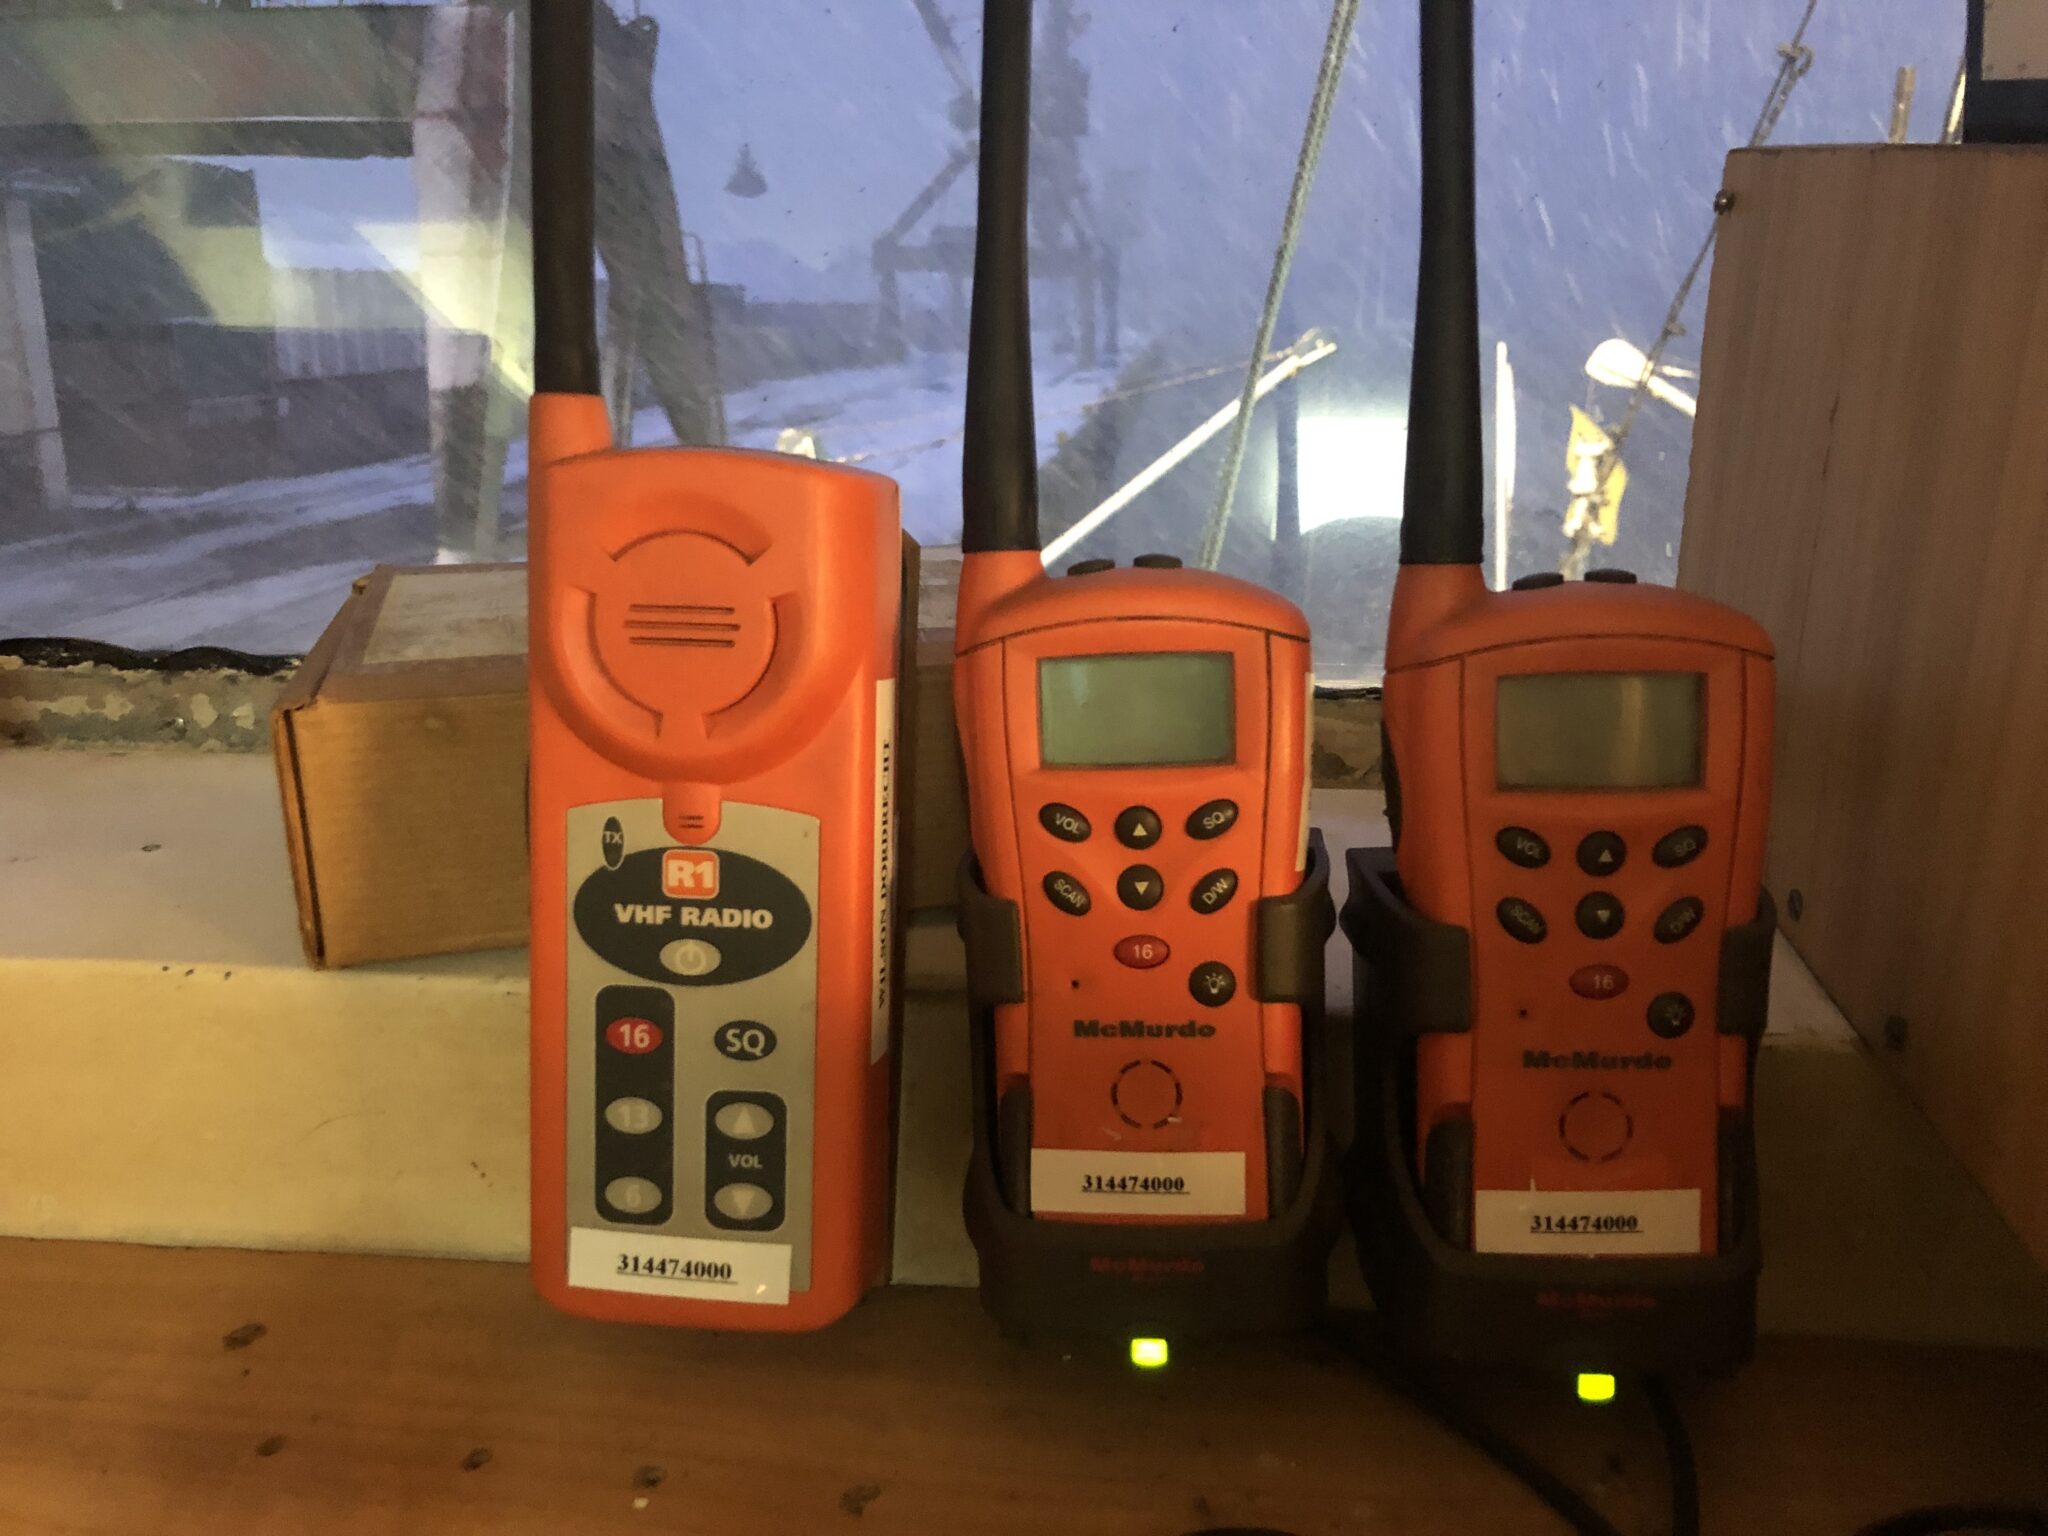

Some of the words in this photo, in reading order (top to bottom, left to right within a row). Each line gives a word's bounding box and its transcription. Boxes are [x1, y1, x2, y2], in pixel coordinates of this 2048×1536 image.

[1055, 812, 1080, 835] VOL
[1202, 810, 1226, 830] SQ
[604, 831, 624, 845] TX
[667, 859, 715, 889] R1
[1053, 878, 1085, 908] SCAN
[614, 903, 673, 925] VHF
[680, 905, 774, 929] RADIO
[1132, 943, 1154, 960] 16
[1593, 974, 1615, 991] 16
[618, 1023, 651, 1049] 16
[1073, 1019, 1217, 1038] McMurdo
[725, 1028, 766, 1056] SQ
[1522, 1050, 1673, 1070] McMurdo
[728, 1153, 764, 1170] VOL
[1081, 1173, 1187, 1194] 314474000
[624, 1183, 642, 1208] 6
[1530, 1214, 1641, 1233] 314474000
[616, 1253, 734, 1282] 314474000
